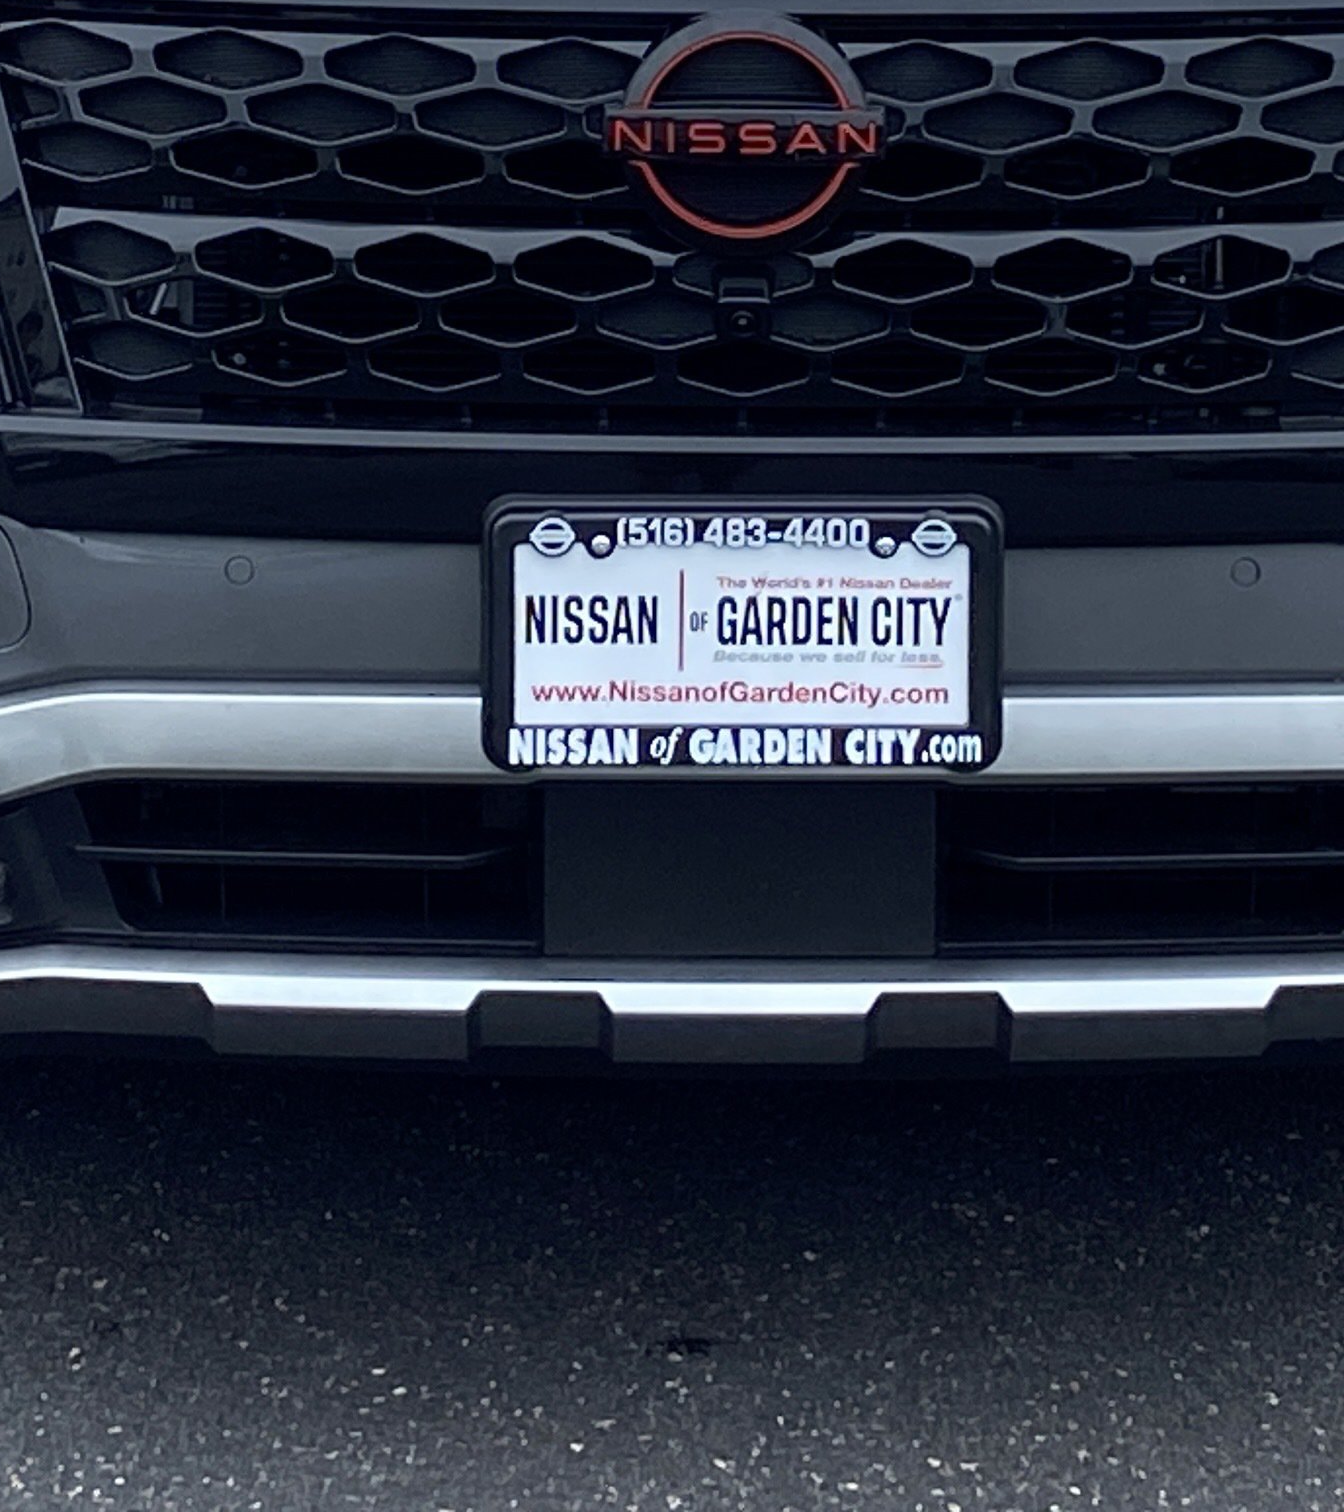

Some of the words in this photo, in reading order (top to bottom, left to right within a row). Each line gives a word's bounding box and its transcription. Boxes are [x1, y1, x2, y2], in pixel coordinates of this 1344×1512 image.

[611, 119, 877, 155] NISSAN
[616, 517, 695, 548] (516)
[703, 517, 871, 548] 483-4400
[716, 576, 747, 589] The
[751, 576, 811, 590] World's
[816, 577, 834, 589] #1
[839, 577, 895, 589] Nissan
[899, 577, 953, 590] Dealer
[525, 595, 658, 645] NISSAN
[689, 611, 709, 632] OF
[717, 595, 859, 646] GARDEN
[870, 595, 953, 647] CITY
[713, 650, 794, 664] Because
[799, 653, 828, 664] we
[833, 651, 866, 664] sell
[871, 651, 895, 664] for
[532, 680, 950, 709] www.NissanofGardenCity.com
[508, 727, 639, 766] NISSAN
[649, 726, 684, 766] of
[689, 727, 832, 766] GARDEN
[845, 728, 983, 766] CITY.com
